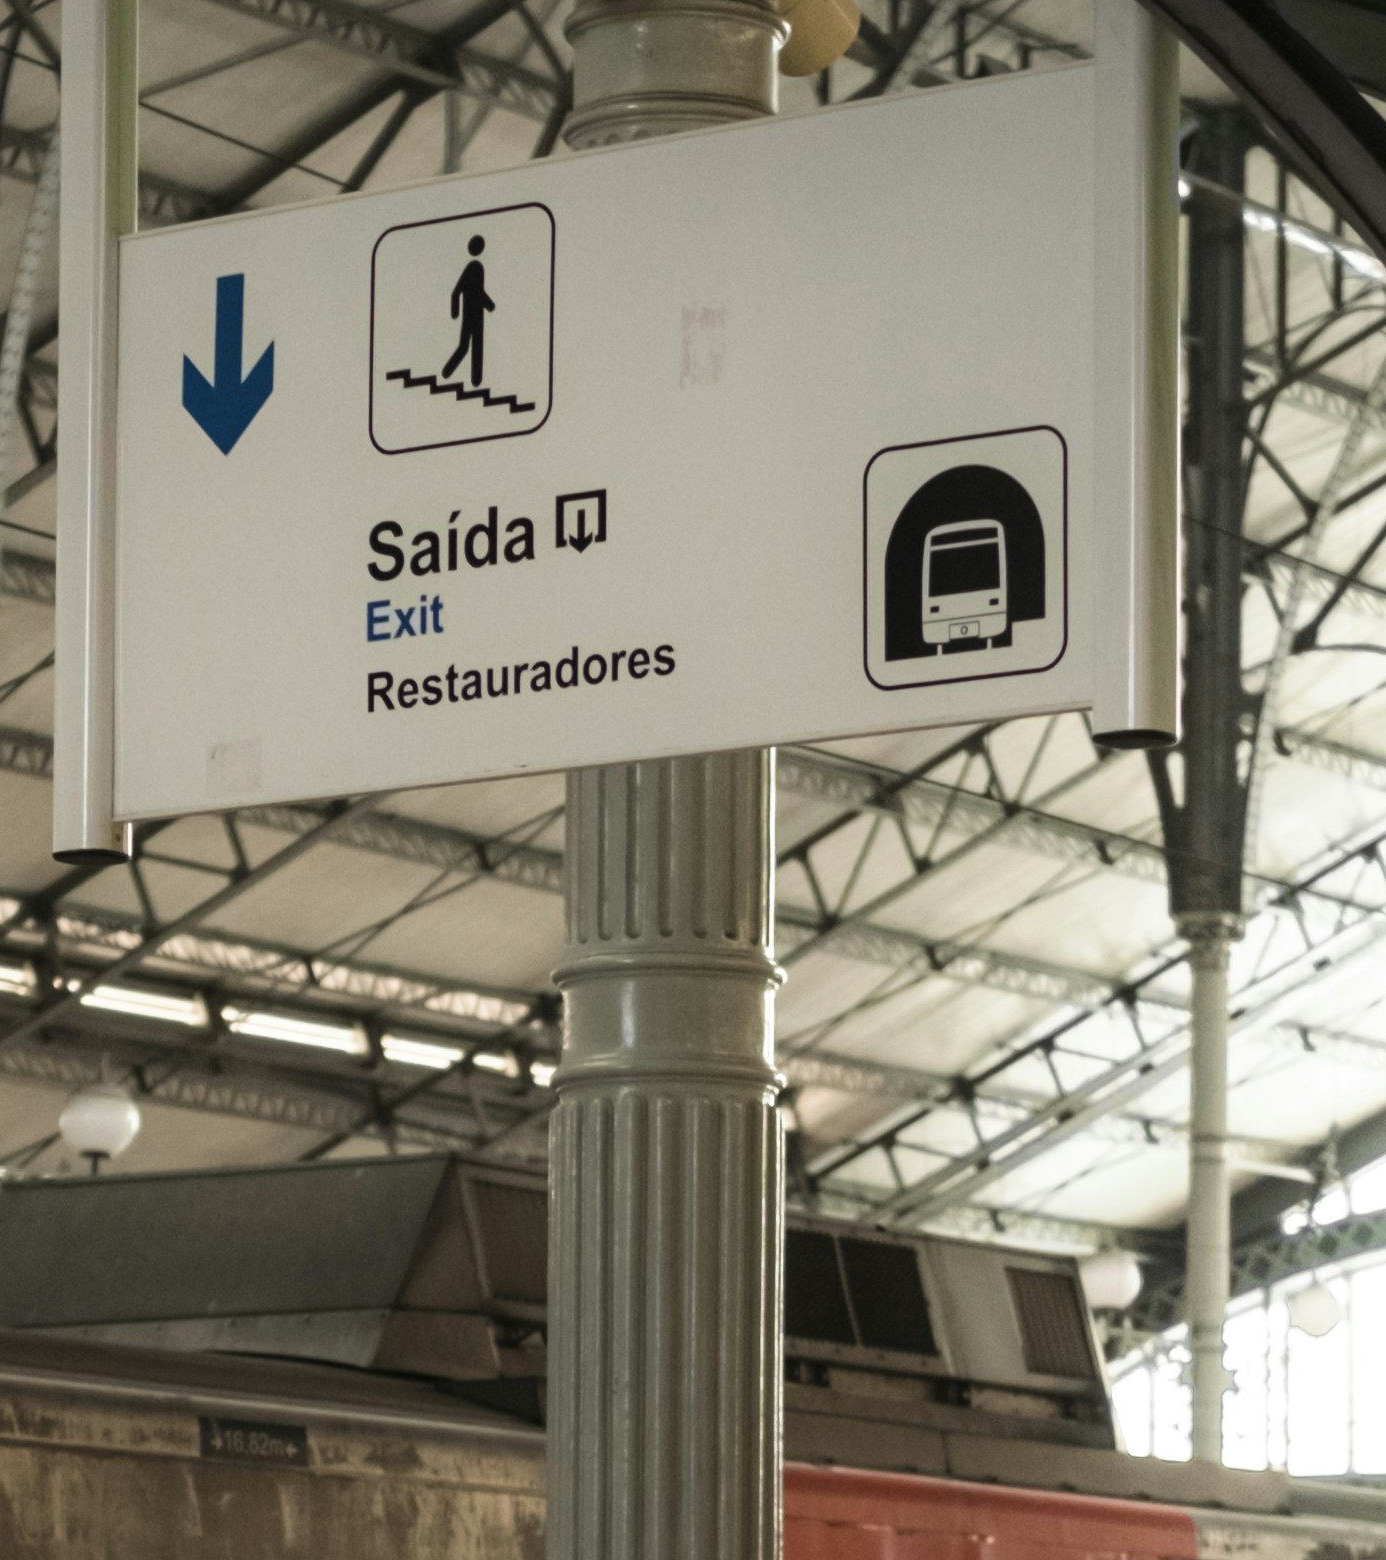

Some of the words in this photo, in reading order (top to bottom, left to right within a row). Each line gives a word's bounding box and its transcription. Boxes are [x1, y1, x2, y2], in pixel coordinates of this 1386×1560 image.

[366, 506, 536, 583] Saída
[365, 595, 445, 643] Exit
[366, 643, 677, 714] Restauradores
